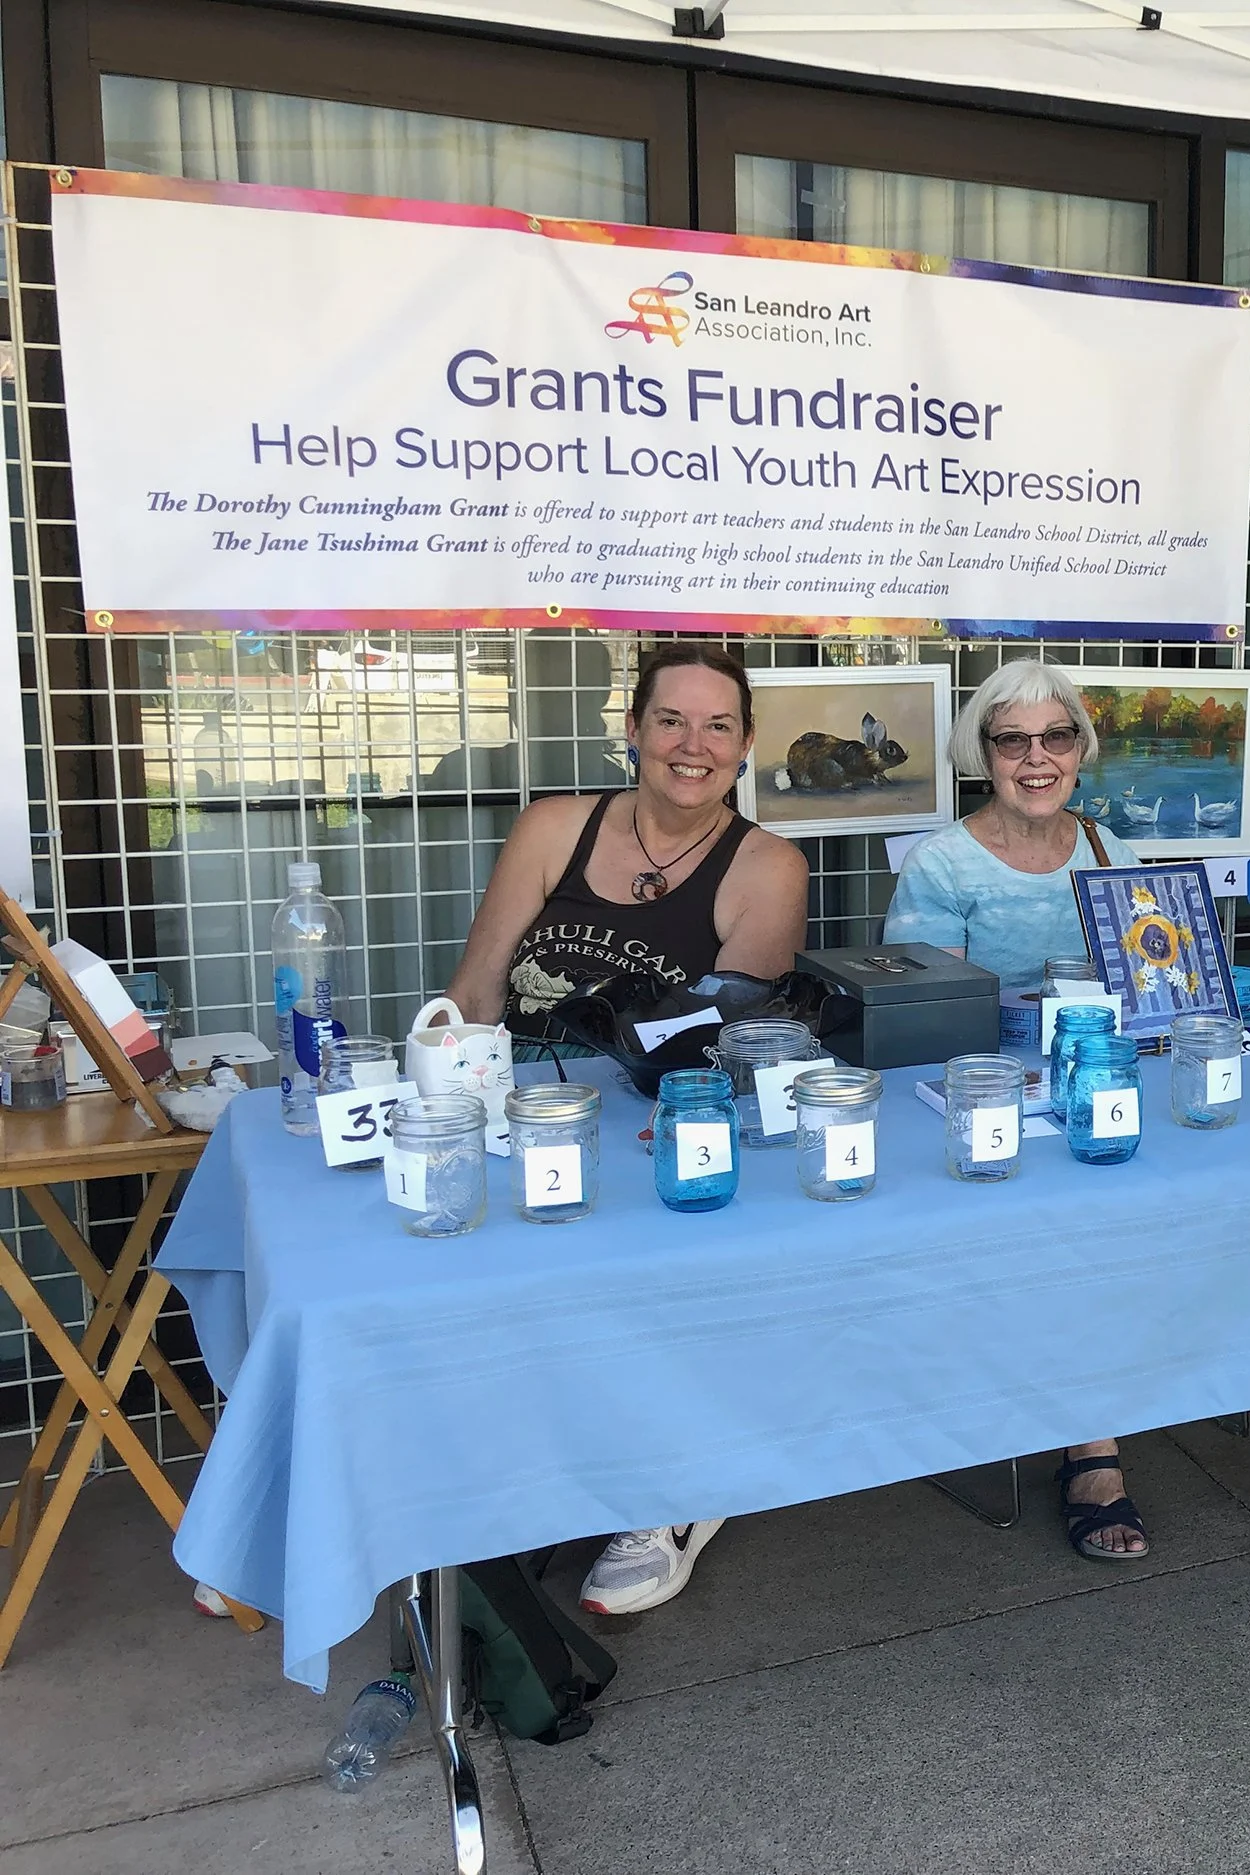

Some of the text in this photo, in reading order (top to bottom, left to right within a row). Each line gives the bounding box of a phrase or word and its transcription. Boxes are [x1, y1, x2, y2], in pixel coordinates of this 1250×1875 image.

[695, 292, 871, 323] San Leandro Art
[695, 317, 871, 347] Association, Inc.
[447, 349, 1002, 441] Grants Fundraiser
[252, 423, 1140, 506] Help Support Local Youth Art Expression
[147, 491, 1208, 552] The Dorothy Cunningham Grant is offered to support art teachers and students in the San Leandro School District, all grades
[212, 531, 1167, 577] The Jane Tsushima Grant is offered to graduating high school students in the San Leandro Unified School District
[528, 564, 949, 598] who are pursuing art in their continuing education
[1224, 870, 1236, 885] 4
[516, 924, 616, 958] AHULI
[554, 943, 648, 975] PRESERV
[1222, 1072, 1231, 1091] 7
[1111, 1103, 1122, 1121] 6
[991, 1129, 1002, 1148] 5
[698, 1146, 710, 1165] 3
[845, 1146, 858, 1165] 4
[400, 1174, 407, 1194] 1
[547, 1170, 560, 1191] 2
[380, 1682, 415, 1705] DASANI
